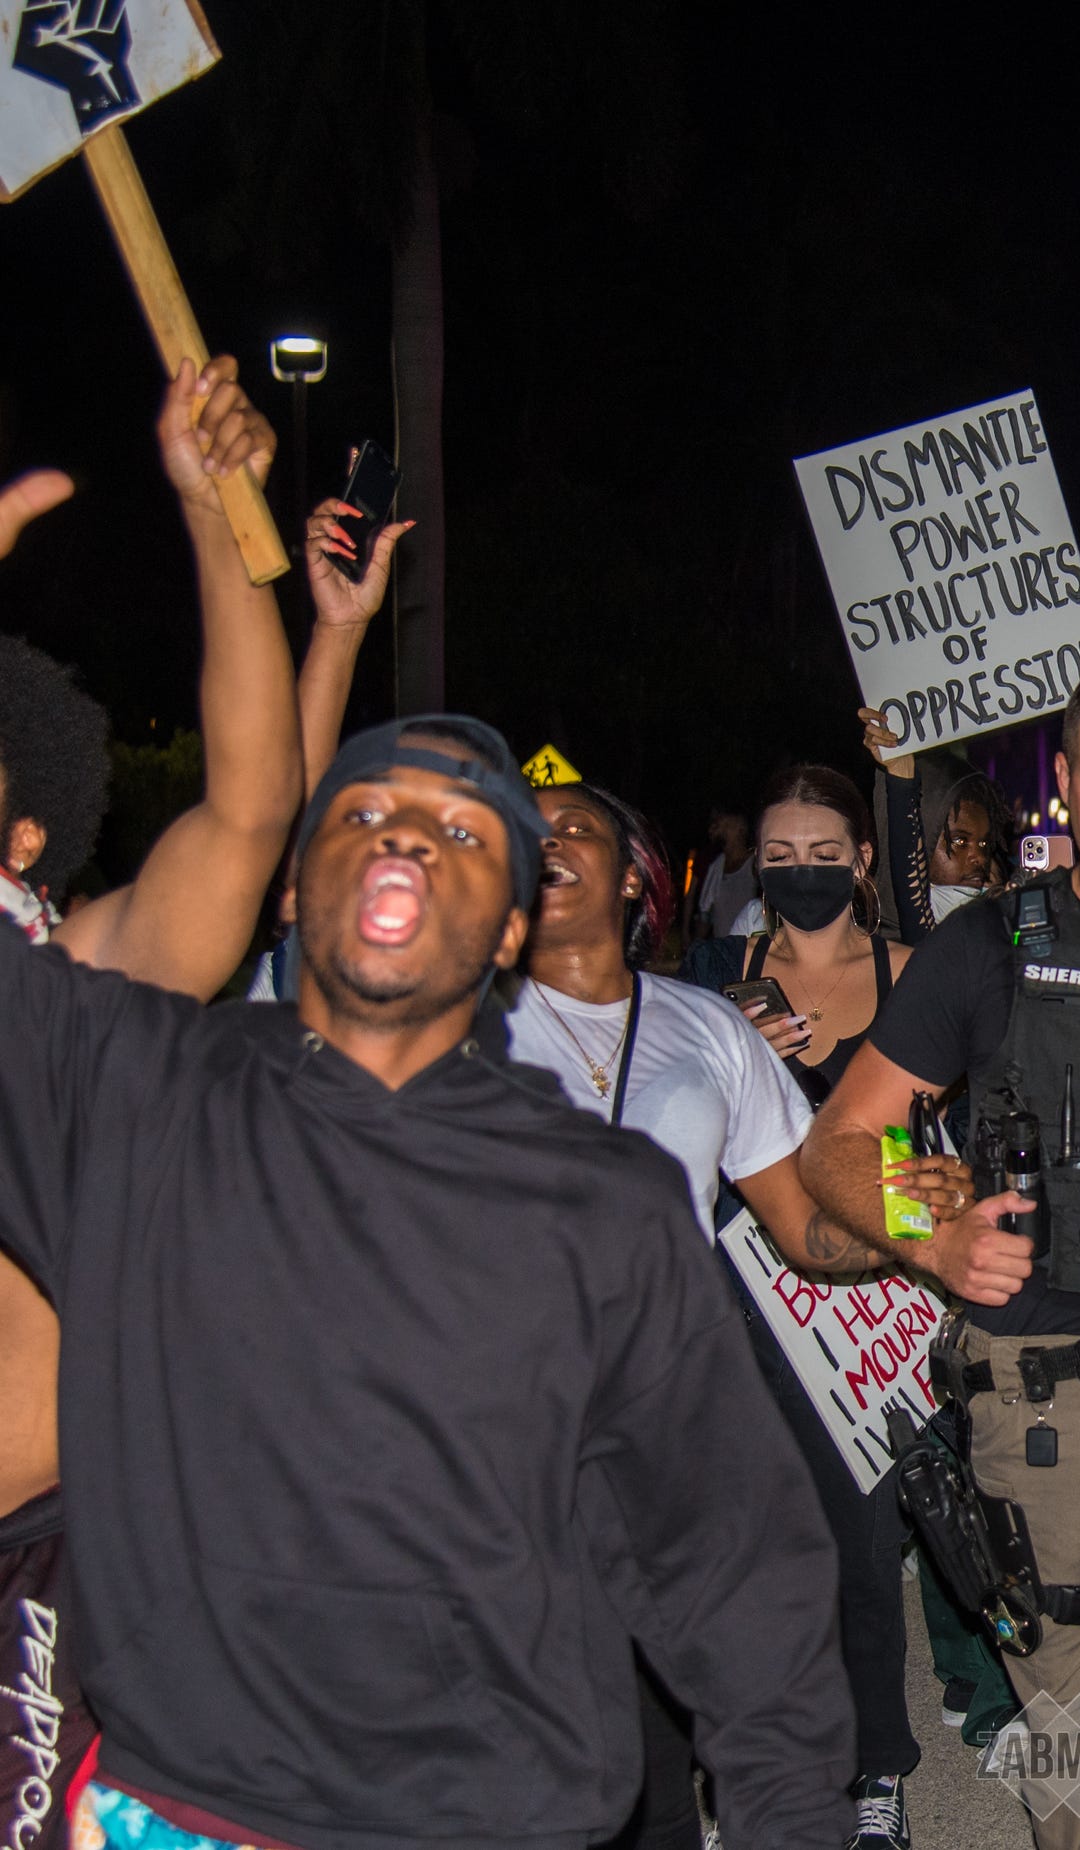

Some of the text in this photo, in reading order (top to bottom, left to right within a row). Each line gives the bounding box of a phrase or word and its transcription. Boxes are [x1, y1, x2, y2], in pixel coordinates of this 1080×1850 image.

[825, 401, 1047, 531] DISMANTLE
[890, 481, 1041, 582] POWER
[942, 626, 988, 664] OF
[771, 1266, 833, 1328] BU
[812, 1326, 840, 1372] I
[845, 1289, 938, 1411] MOURN
[0, 1598, 64, 1850] DEADPOO
